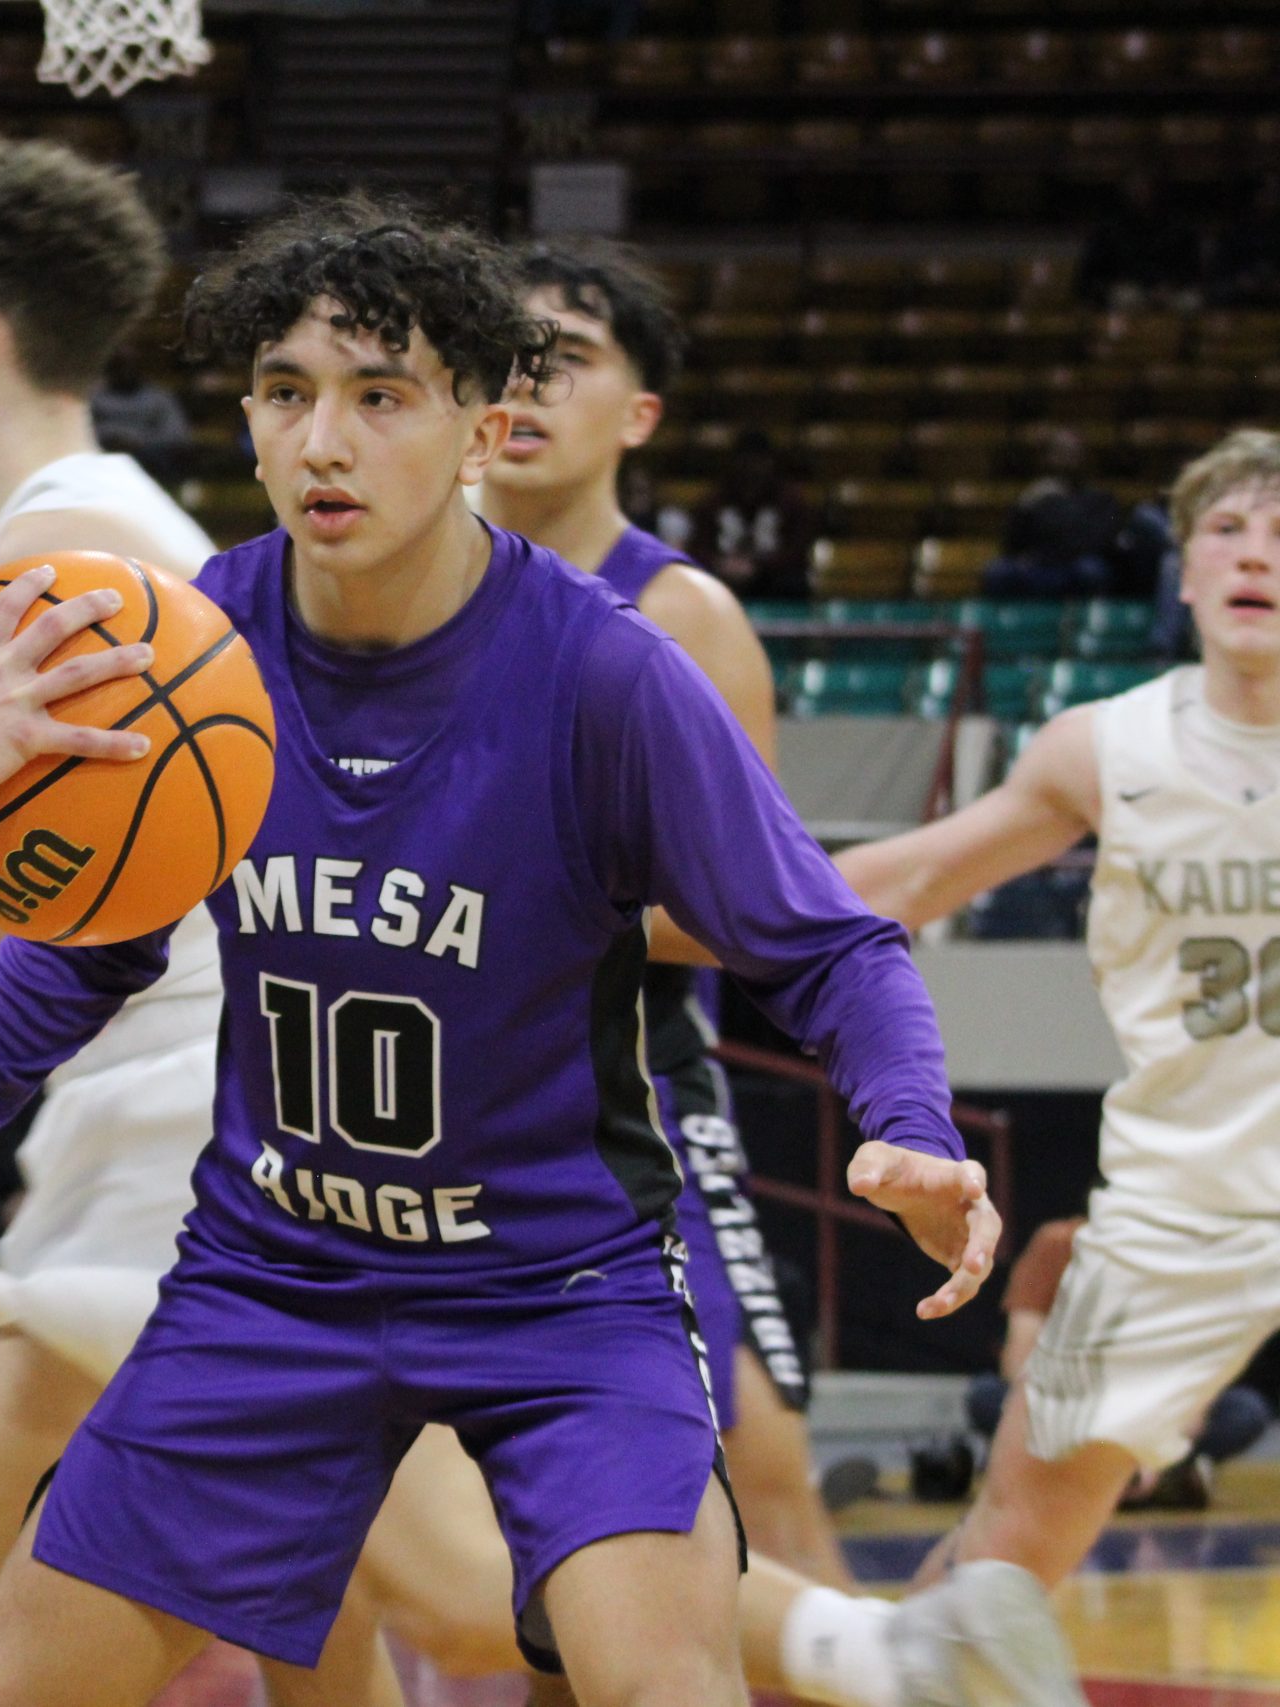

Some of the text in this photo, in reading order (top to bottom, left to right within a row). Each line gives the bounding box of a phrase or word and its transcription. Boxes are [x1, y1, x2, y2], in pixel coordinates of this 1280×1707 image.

[231, 854, 485, 970] MESA
[258, 970, 442, 1158] 10
[250, 1140, 493, 1244] RIDGE
